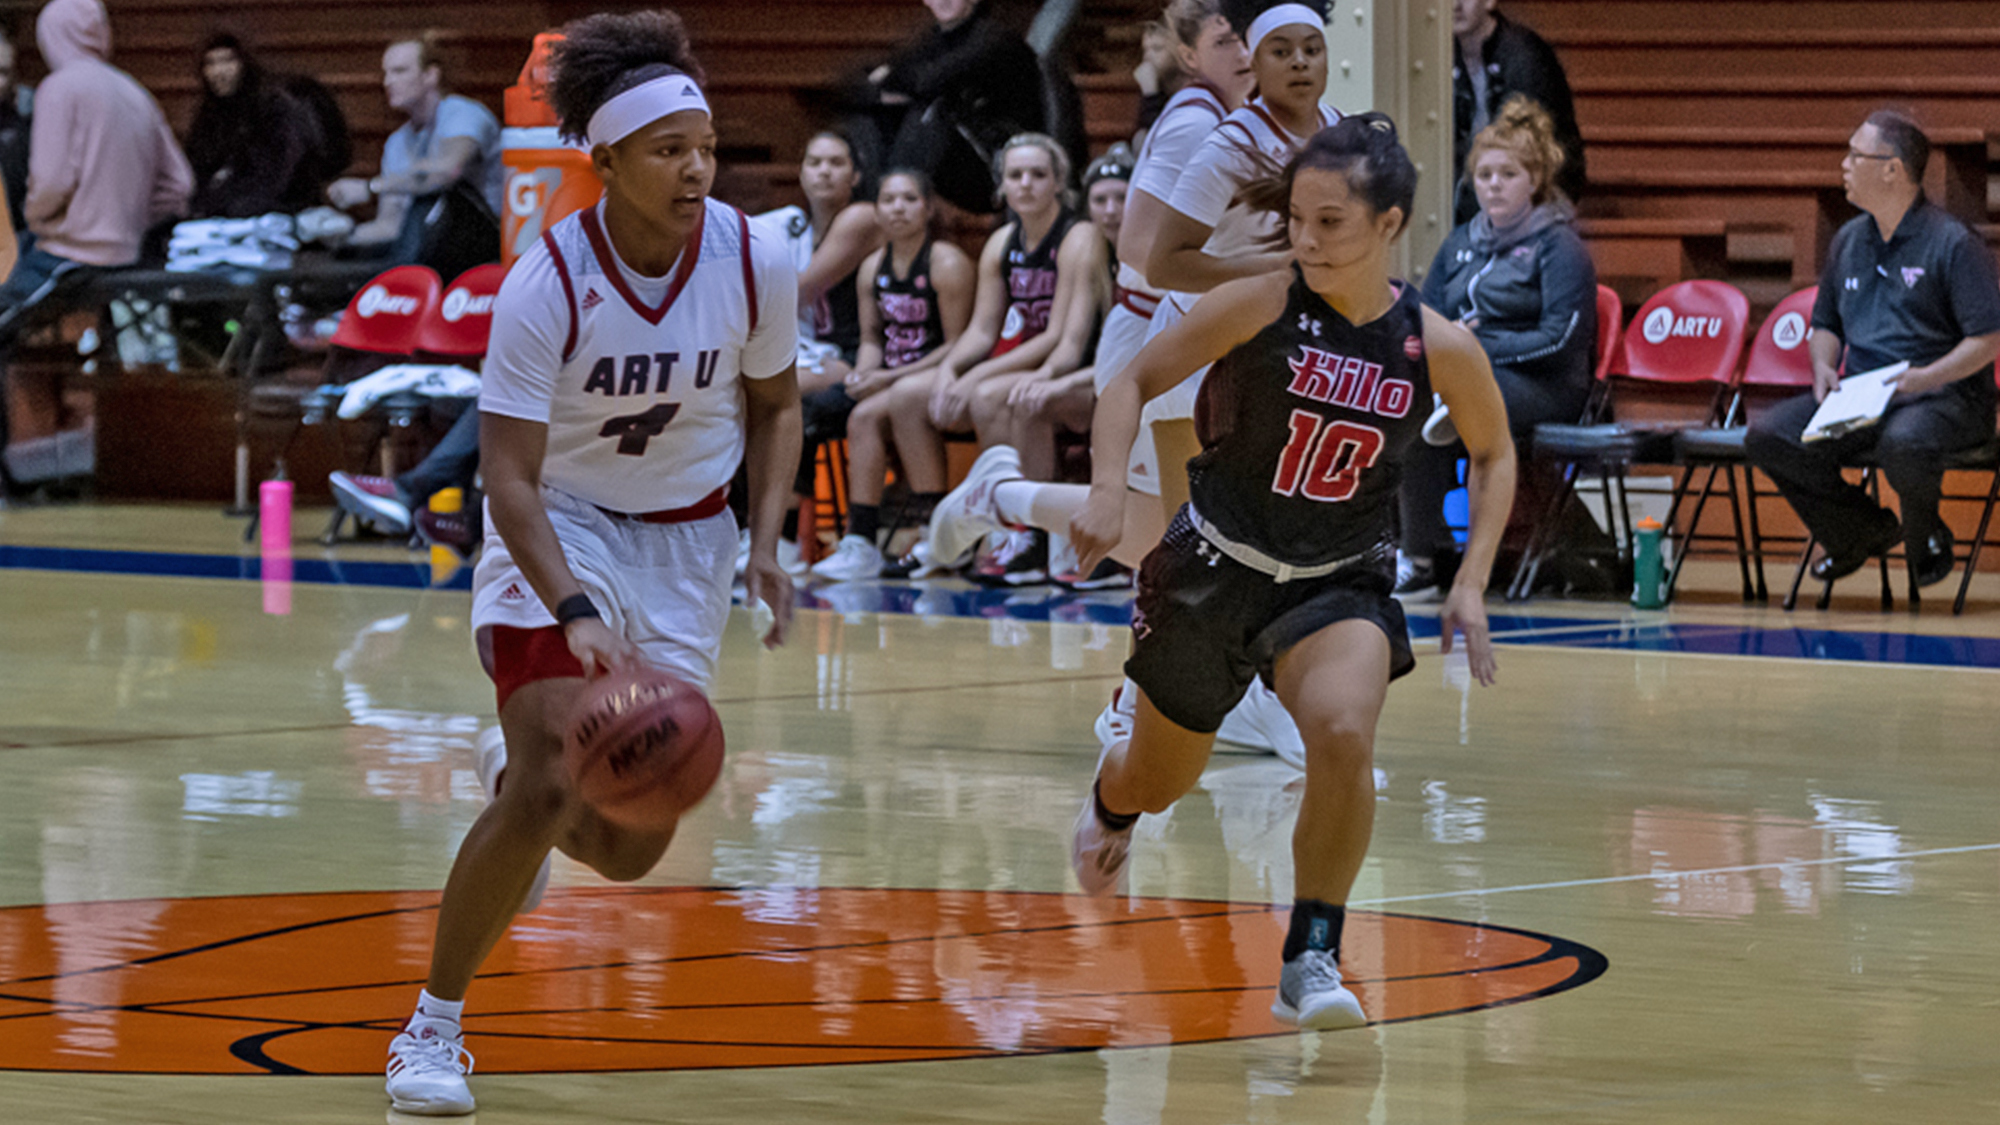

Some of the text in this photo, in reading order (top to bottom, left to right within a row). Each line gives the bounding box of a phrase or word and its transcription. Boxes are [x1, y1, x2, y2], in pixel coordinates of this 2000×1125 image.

[582, 348, 721, 397] ART U
[1286, 344, 1415, 420] Hilo
[598, 401, 682, 458] 4
[1271, 408, 1386, 503] 10
